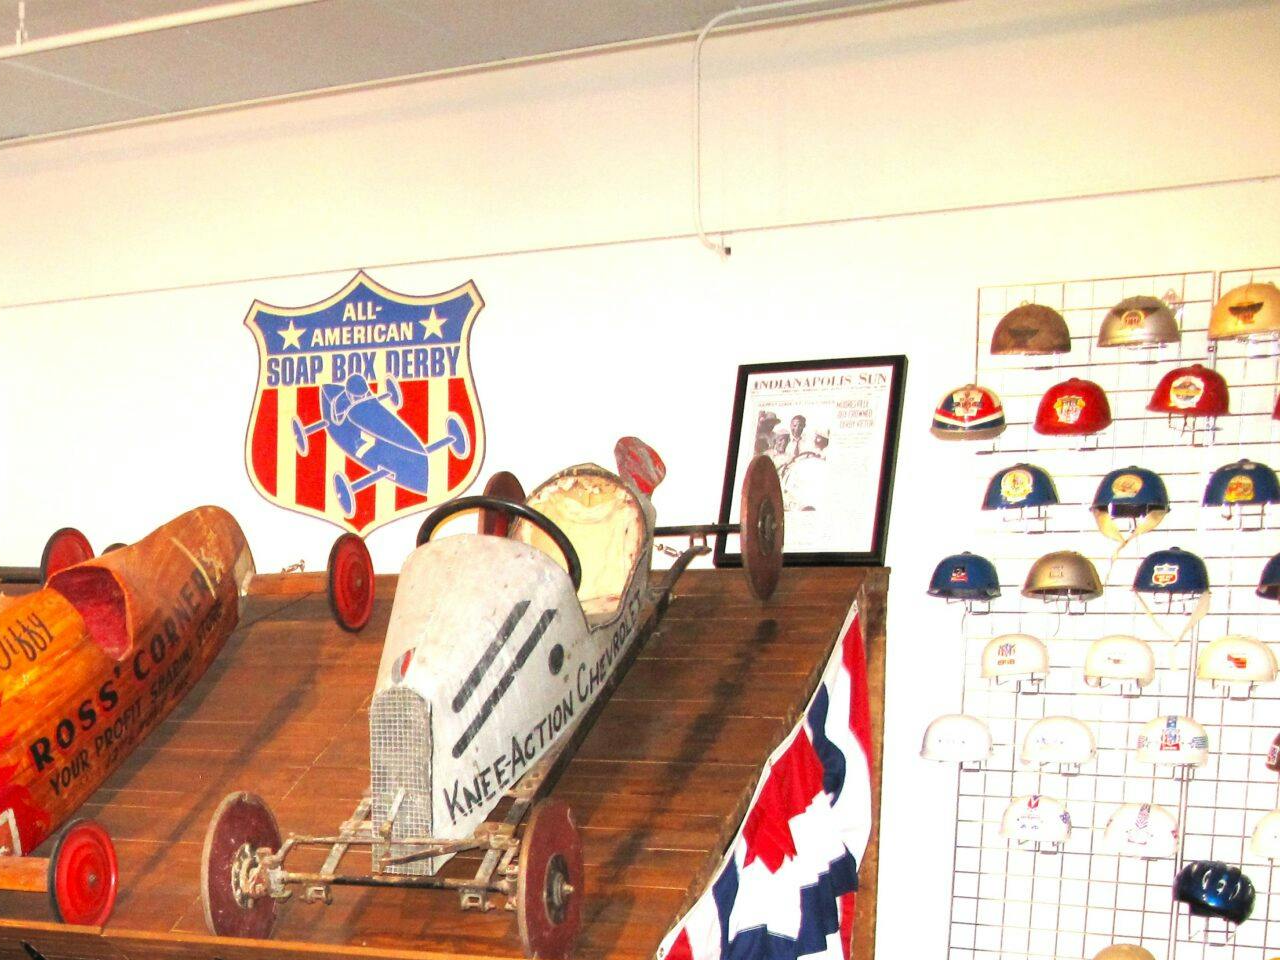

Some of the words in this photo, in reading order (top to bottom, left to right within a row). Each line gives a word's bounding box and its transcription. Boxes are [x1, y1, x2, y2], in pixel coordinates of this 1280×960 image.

[342, 302, 383, 321] ALL-
[310, 322, 413, 347] AMERICAN
[266, 355, 323, 386] SOAP
[331, 352, 376, 383] BOX
[385, 345, 461, 379] DERBY
[752, 375, 852, 390] INDIANAPOLIS
[355, 431, 376, 459] 7
[29, 665, 121, 772] ROSS'
[49, 749, 90, 796] YOUR
